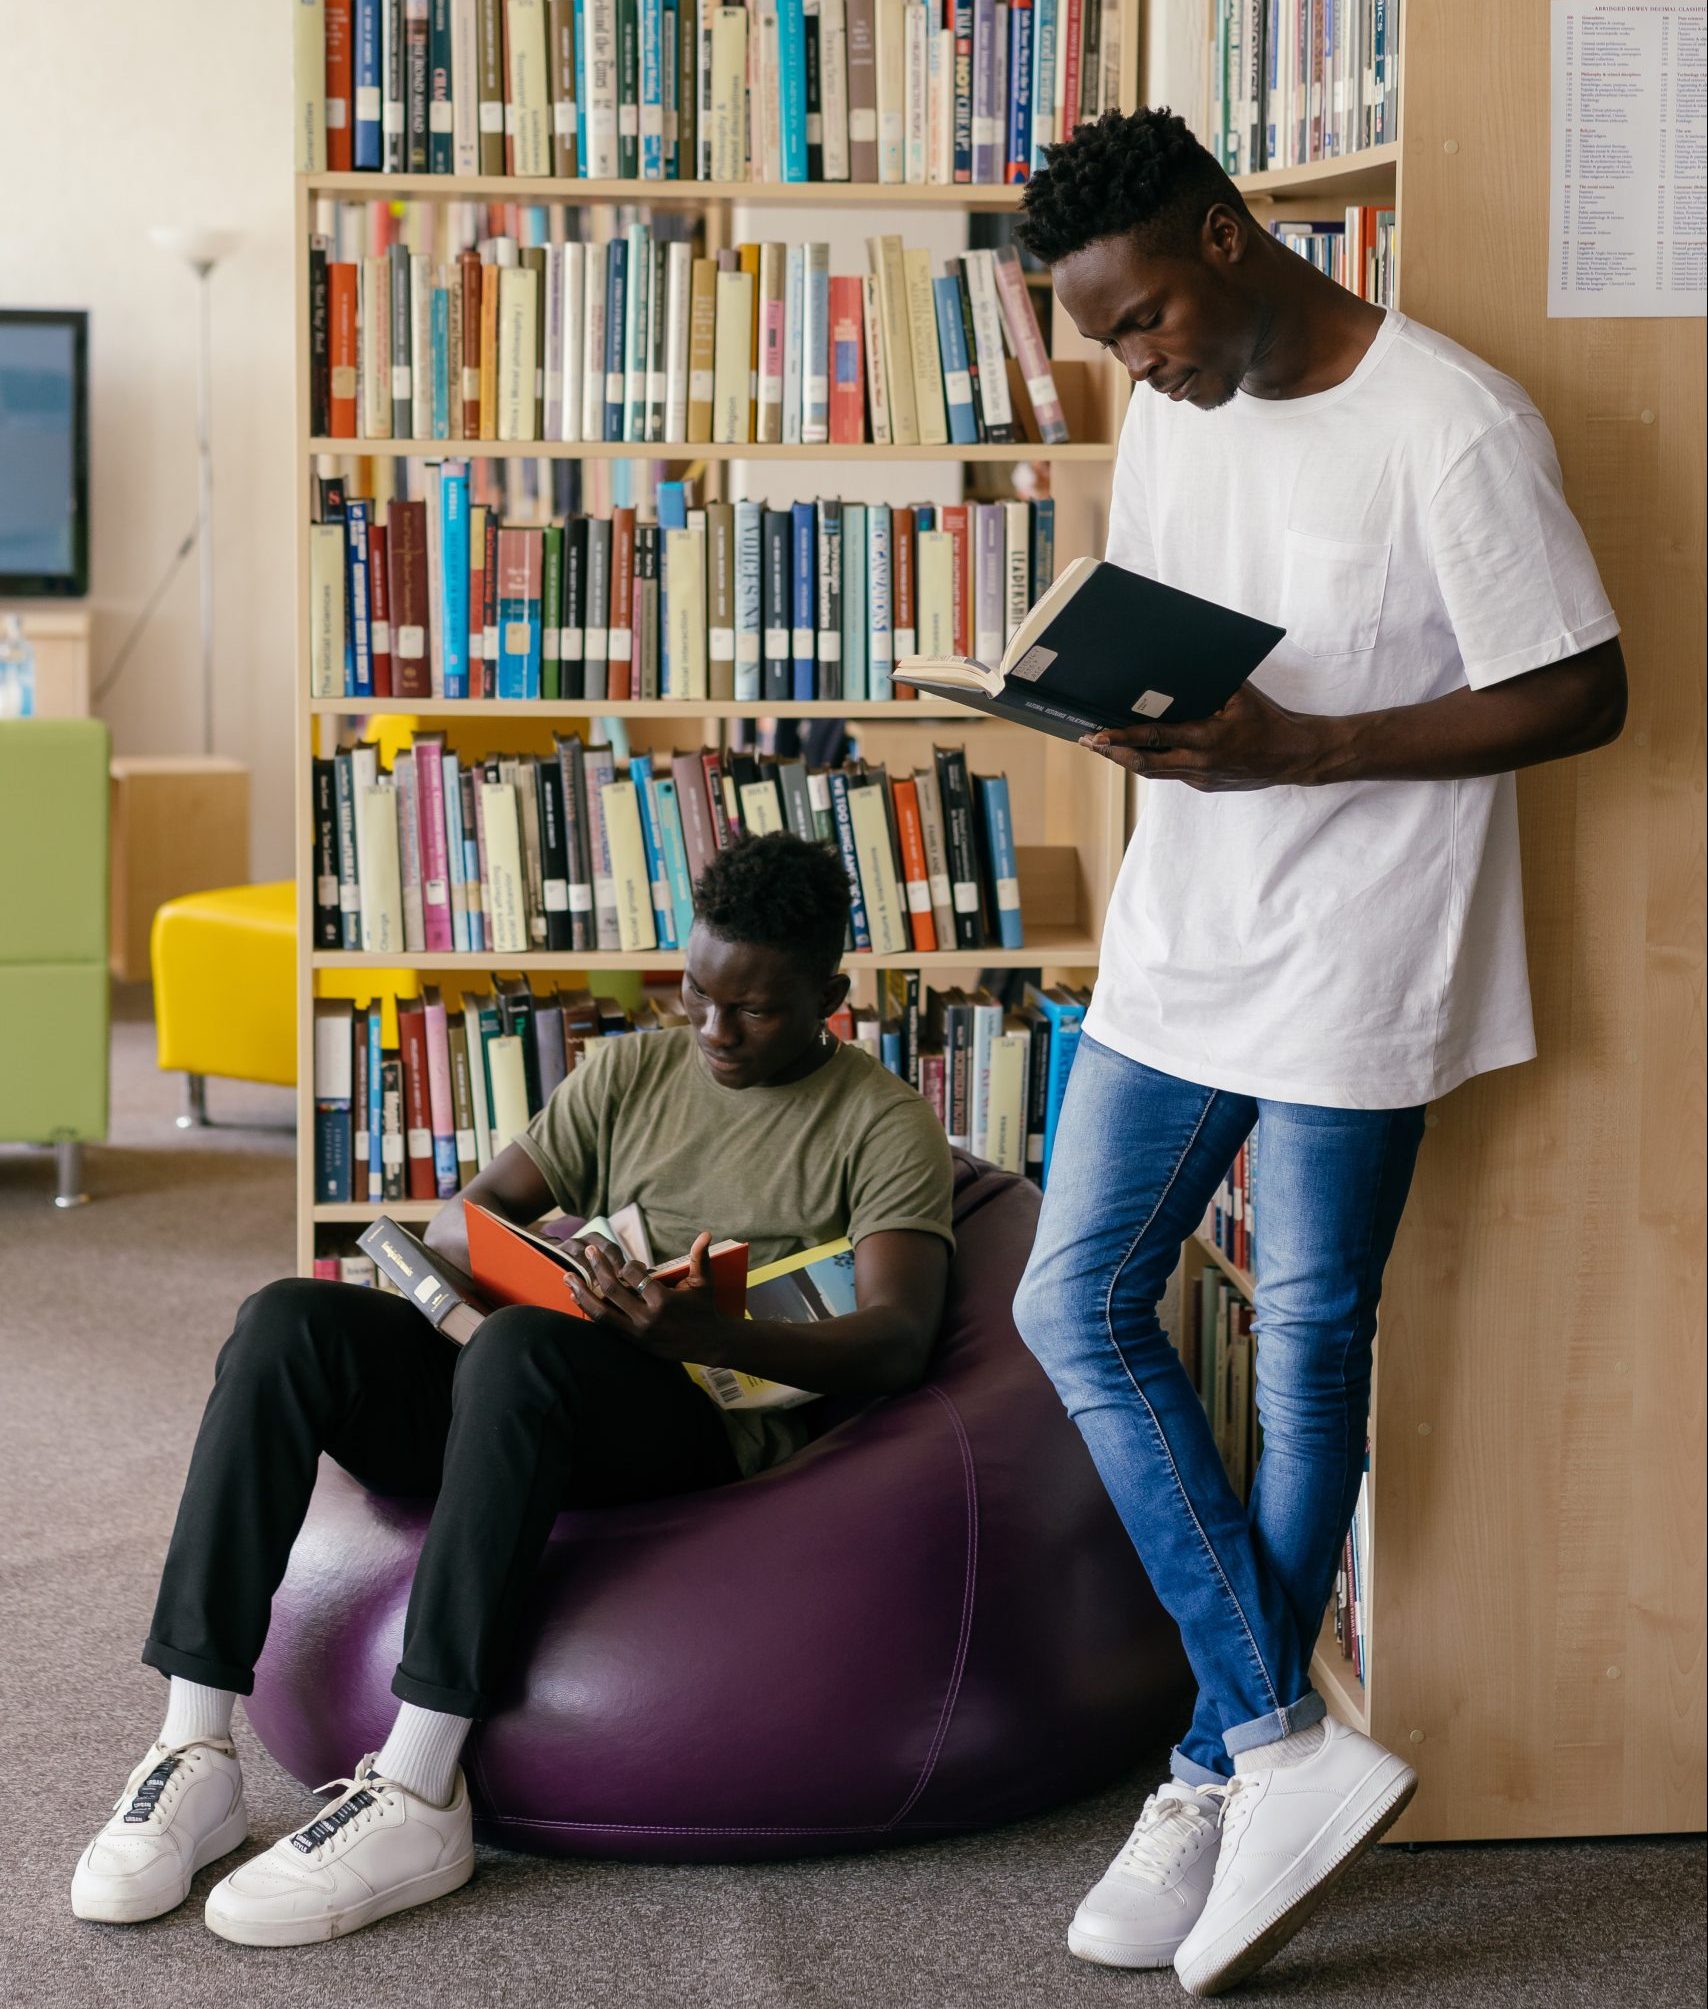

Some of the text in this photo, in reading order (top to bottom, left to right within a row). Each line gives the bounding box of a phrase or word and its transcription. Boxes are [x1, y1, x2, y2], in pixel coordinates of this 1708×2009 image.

[414, 61, 425, 92] ROAD
[955, 56, 971, 96] NOT
[303, 102, 316, 172] Generalities
[511, 310, 523, 367] philosophy
[727, 396, 739, 443] Religion
[742, 525, 760, 596] VOICES
[872, 528, 888, 632] ORGANIZATIONS
[320, 584, 332, 696] The social sciences
[679, 610, 691, 698] Social interaction
[832, 777, 846, 795] WE
[834, 797, 849, 822] TOO
[838, 824, 853, 853] SING
[504, 873, 515, 916] behavior
[870, 847, 884, 902] institutions
[379, 912, 390, 951] Change
[625, 879, 640, 947] Social groups
[881, 915, 893, 951] Culture
[998, 1116, 1008, 1155] process
